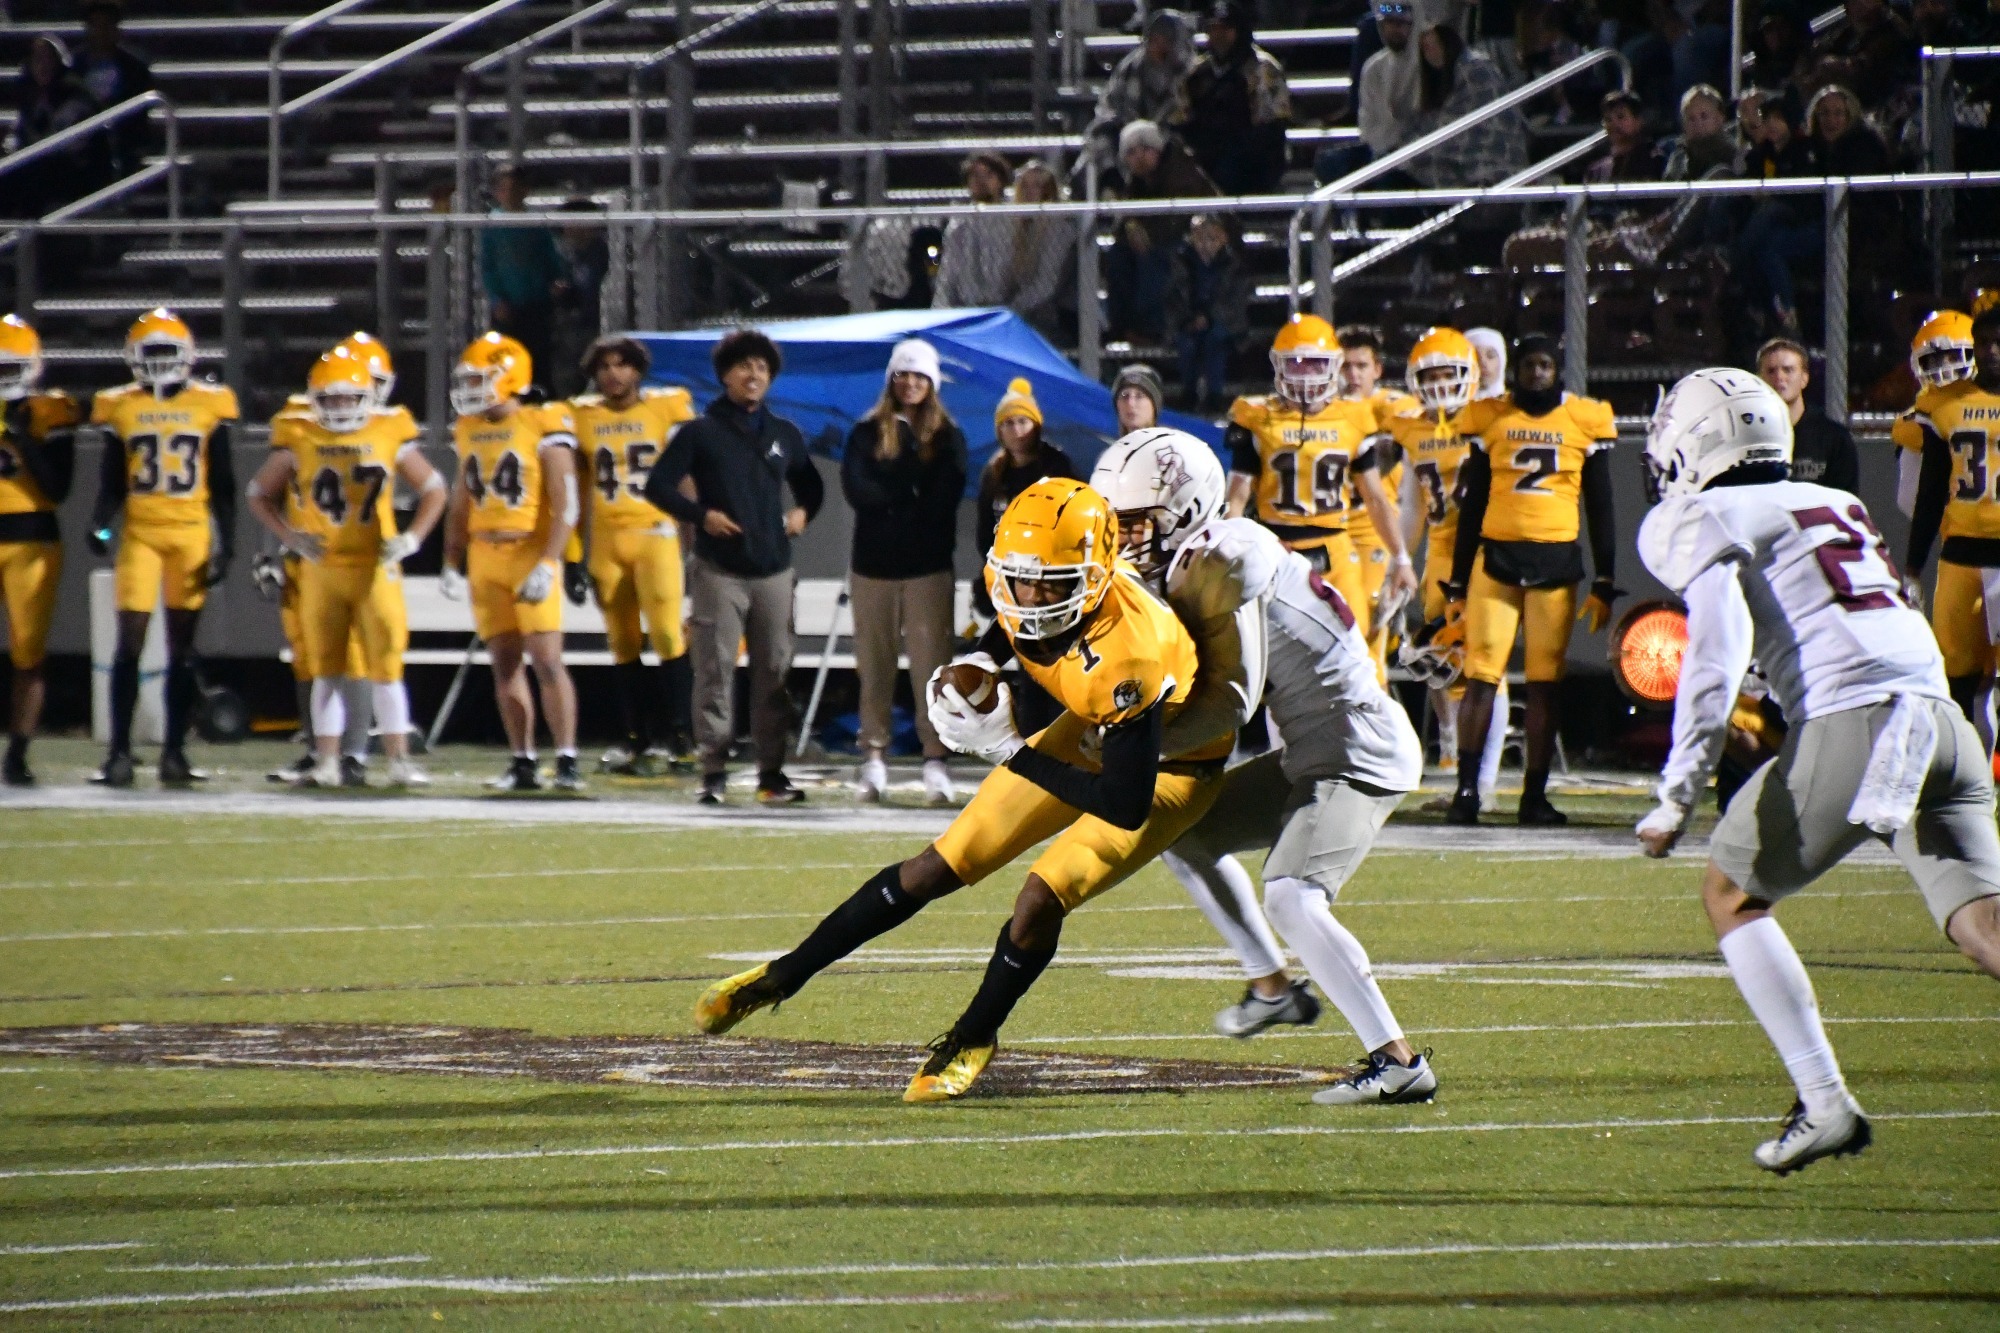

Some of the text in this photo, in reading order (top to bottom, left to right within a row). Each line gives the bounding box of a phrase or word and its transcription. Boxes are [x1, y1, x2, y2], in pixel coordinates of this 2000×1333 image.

[1283, 429, 1338, 443] HAWKS
[1507, 430, 1563, 445] HAWKS
[127, 433, 200, 493] 33
[463, 452, 523, 505] 44
[595, 444, 658, 501] 45
[1513, 446, 1558, 493] 2
[1949, 430, 2000, 500] 3
[313, 466, 386, 525] 47
[1078, 636, 1102, 673] 1
